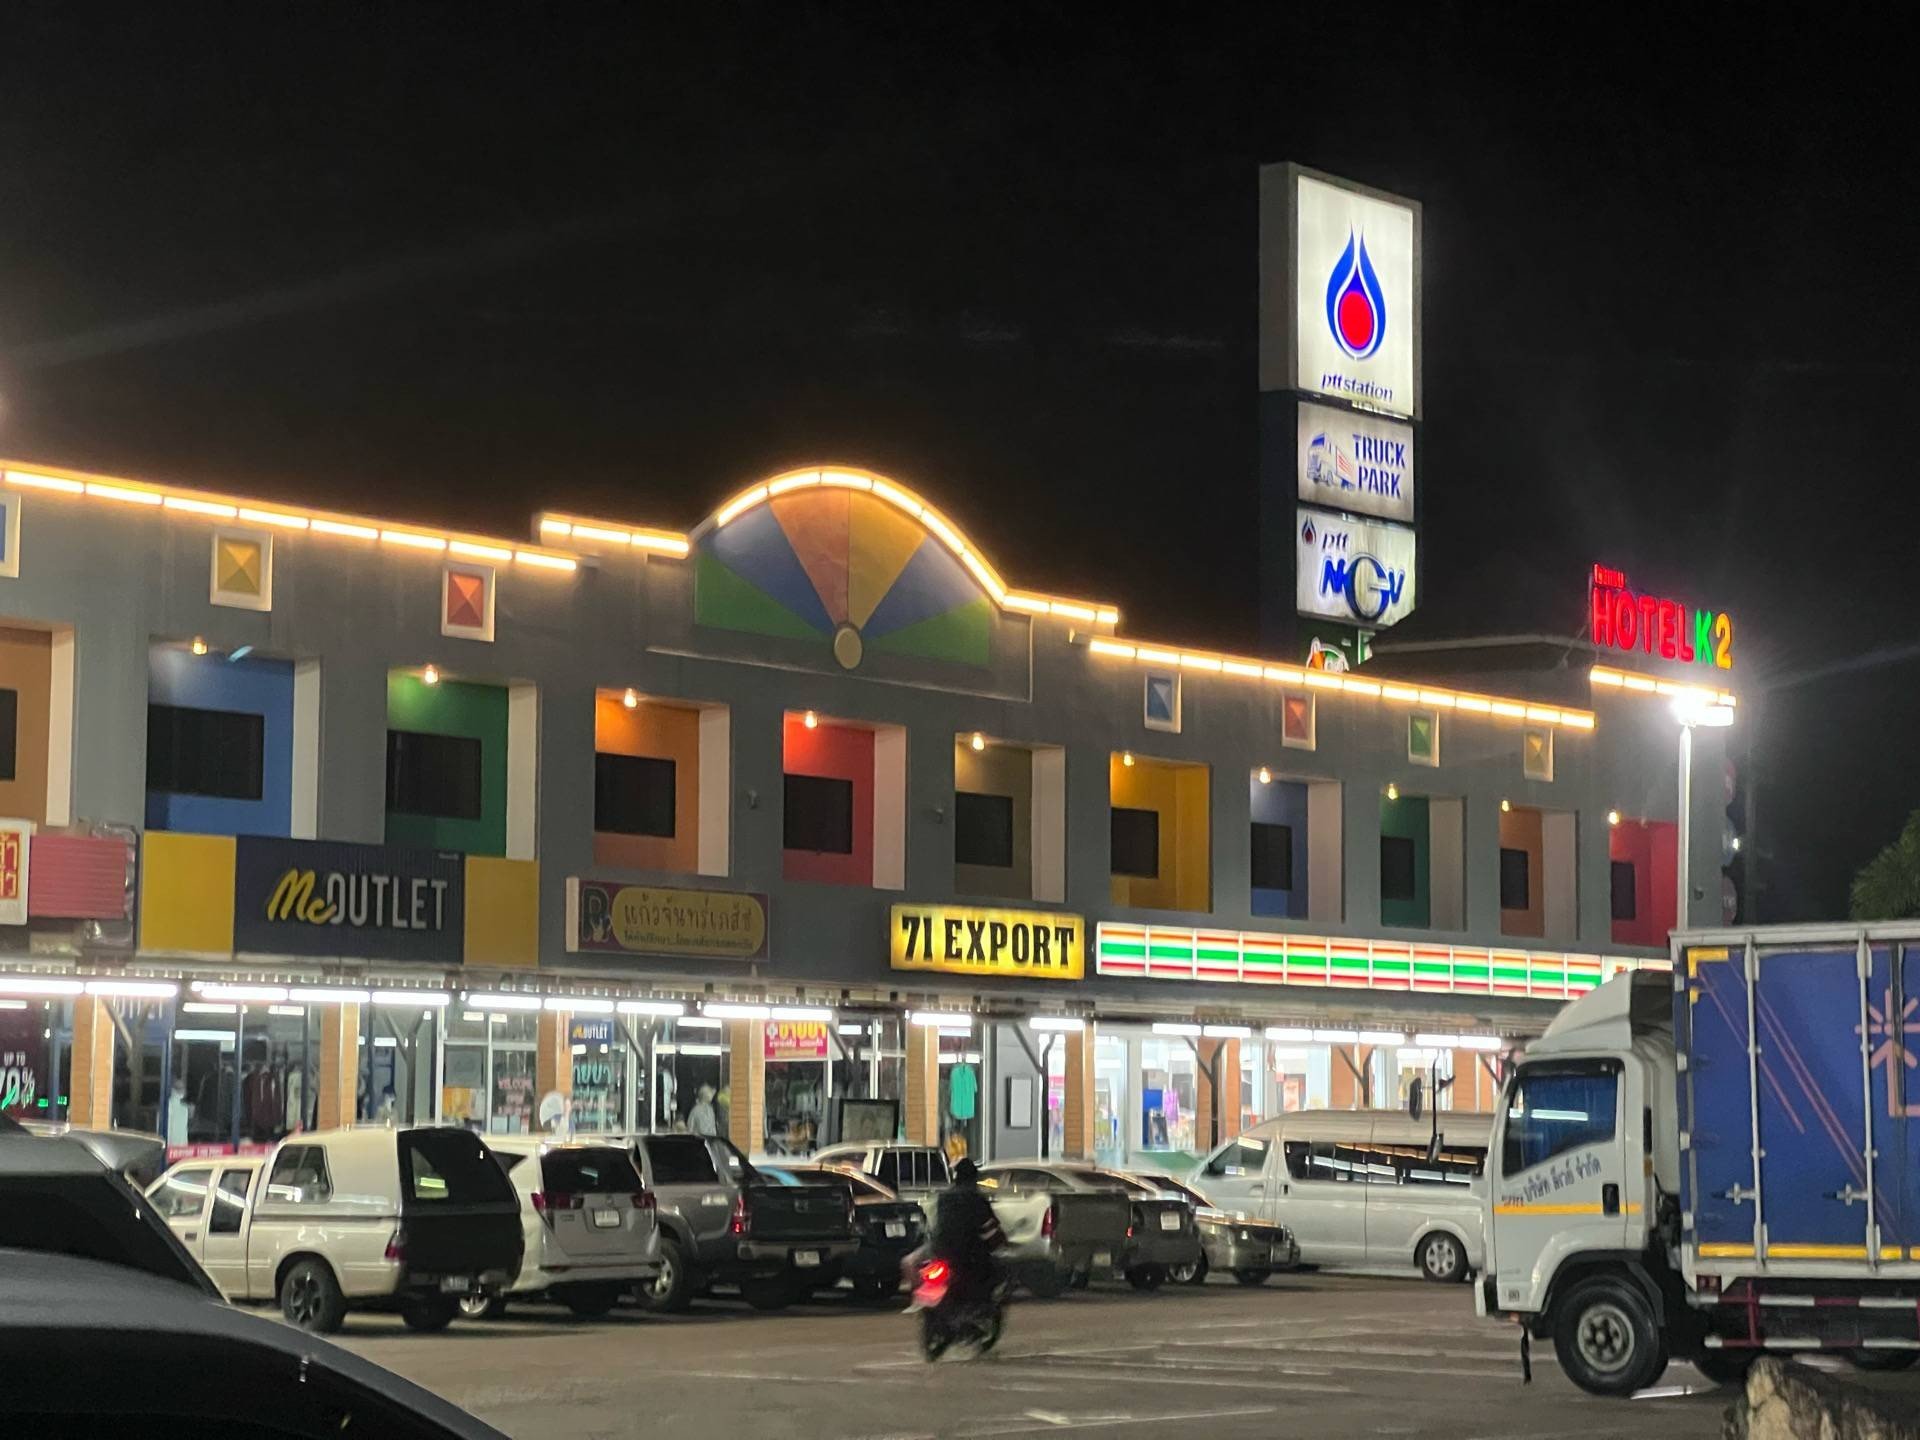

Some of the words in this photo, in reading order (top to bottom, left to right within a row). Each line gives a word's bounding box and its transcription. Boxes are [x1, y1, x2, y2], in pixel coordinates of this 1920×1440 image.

[1321, 373, 1342, 390] ptt
[1343, 378, 1393, 401] station
[1352, 433, 1405, 469] TRUCK
[1358, 465, 1401, 499] PARK
[1320, 551, 1405, 622] NGV
[1592, 586, 1694, 663] HOTEL
[1695, 608, 1732, 671] K2
[944, 918, 1075, 969] EXPORT
